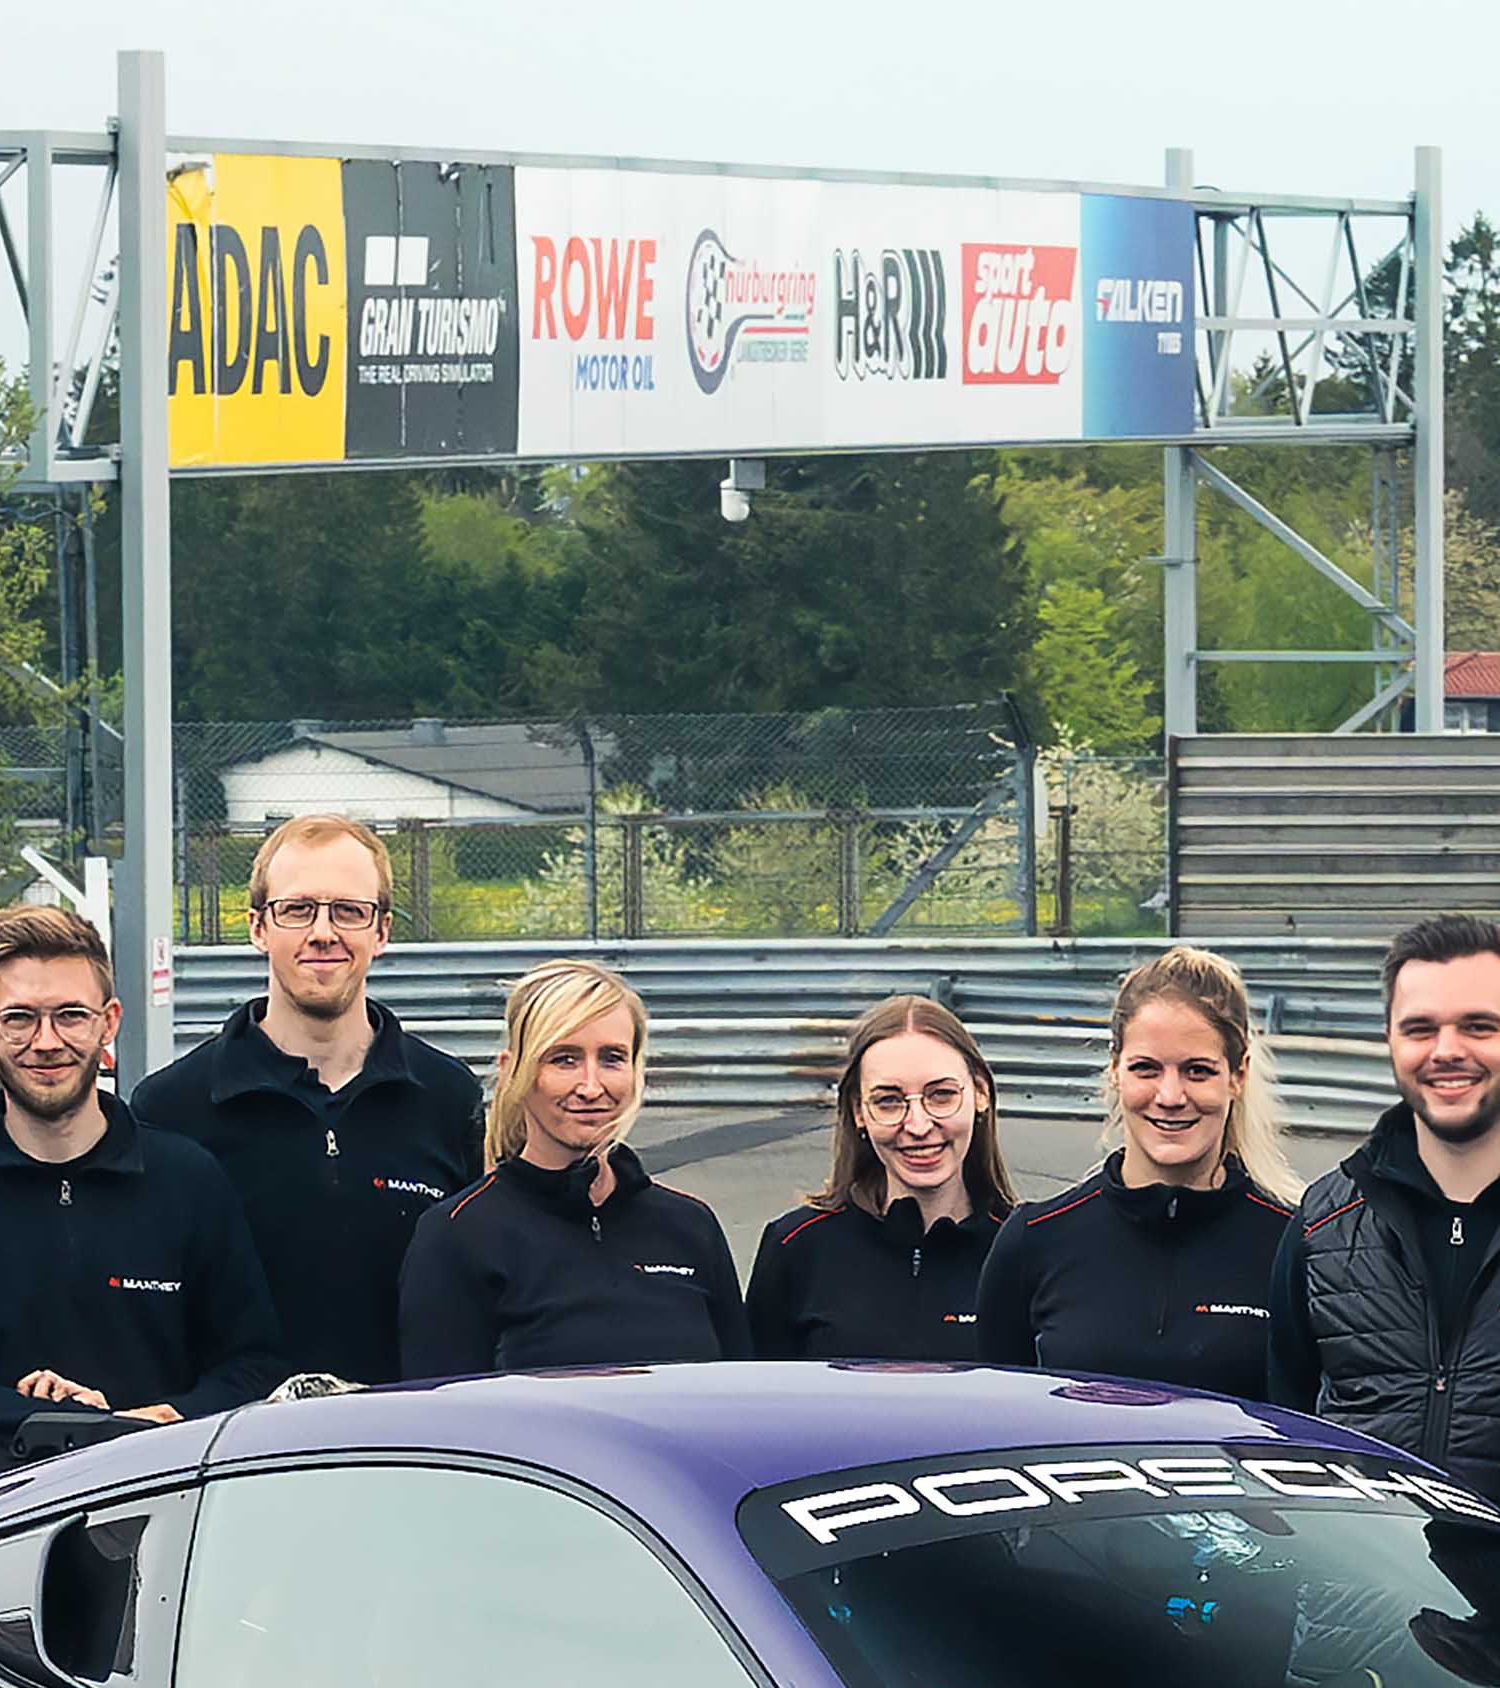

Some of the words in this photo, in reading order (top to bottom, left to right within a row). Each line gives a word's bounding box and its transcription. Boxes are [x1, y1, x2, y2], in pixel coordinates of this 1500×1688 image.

[168, 223, 330, 397] ADAC
[531, 236, 657, 342] ROWE
[974, 247, 1037, 299] sport
[1096, 278, 1183, 323] FALKEN
[359, 298, 412, 357] GRAN
[414, 297, 499, 357] TURISMO
[835, 248, 912, 382] H&R
[967, 286, 1075, 377] auto
[575, 355, 629, 391] MOTOR
[632, 356, 655, 391] OIL
